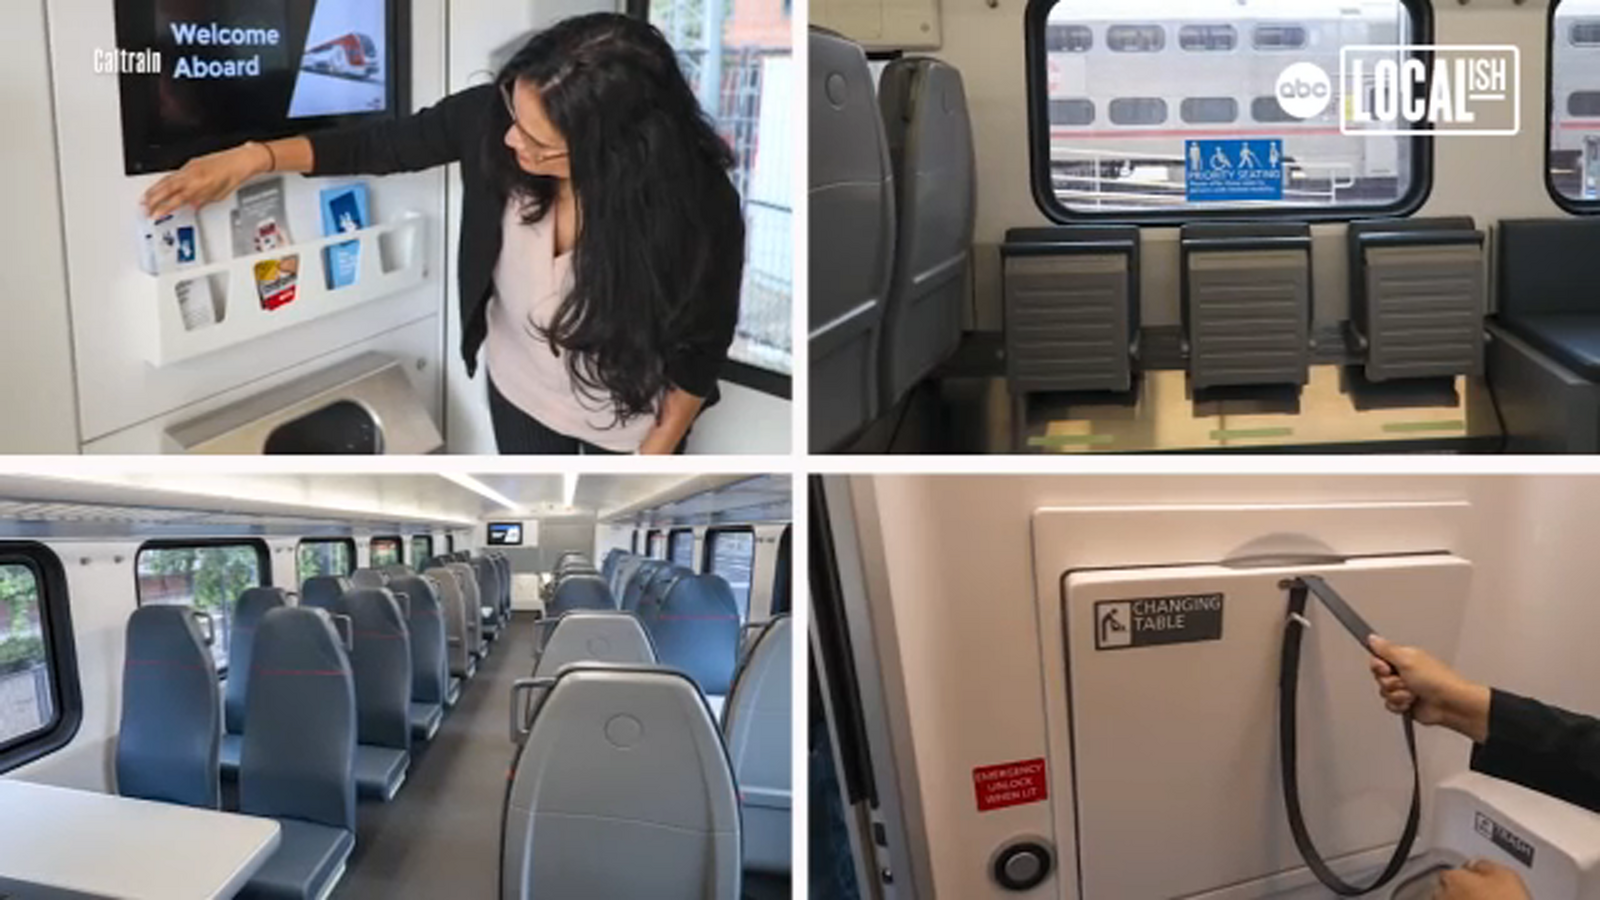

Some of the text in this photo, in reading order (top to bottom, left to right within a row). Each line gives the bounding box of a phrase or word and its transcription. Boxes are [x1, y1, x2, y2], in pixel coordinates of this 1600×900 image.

[170, 22, 280, 46] Welcome
[173, 55, 260, 79] Aboard
[1132, 595, 1221, 616] CHANGING
[1134, 614, 1186, 631] TABLE
[975, 763, 1043, 783] EMERGENCY
[986, 777, 1034, 792] UNLOCK
[985, 786, 1038, 805] WHEN LIT
